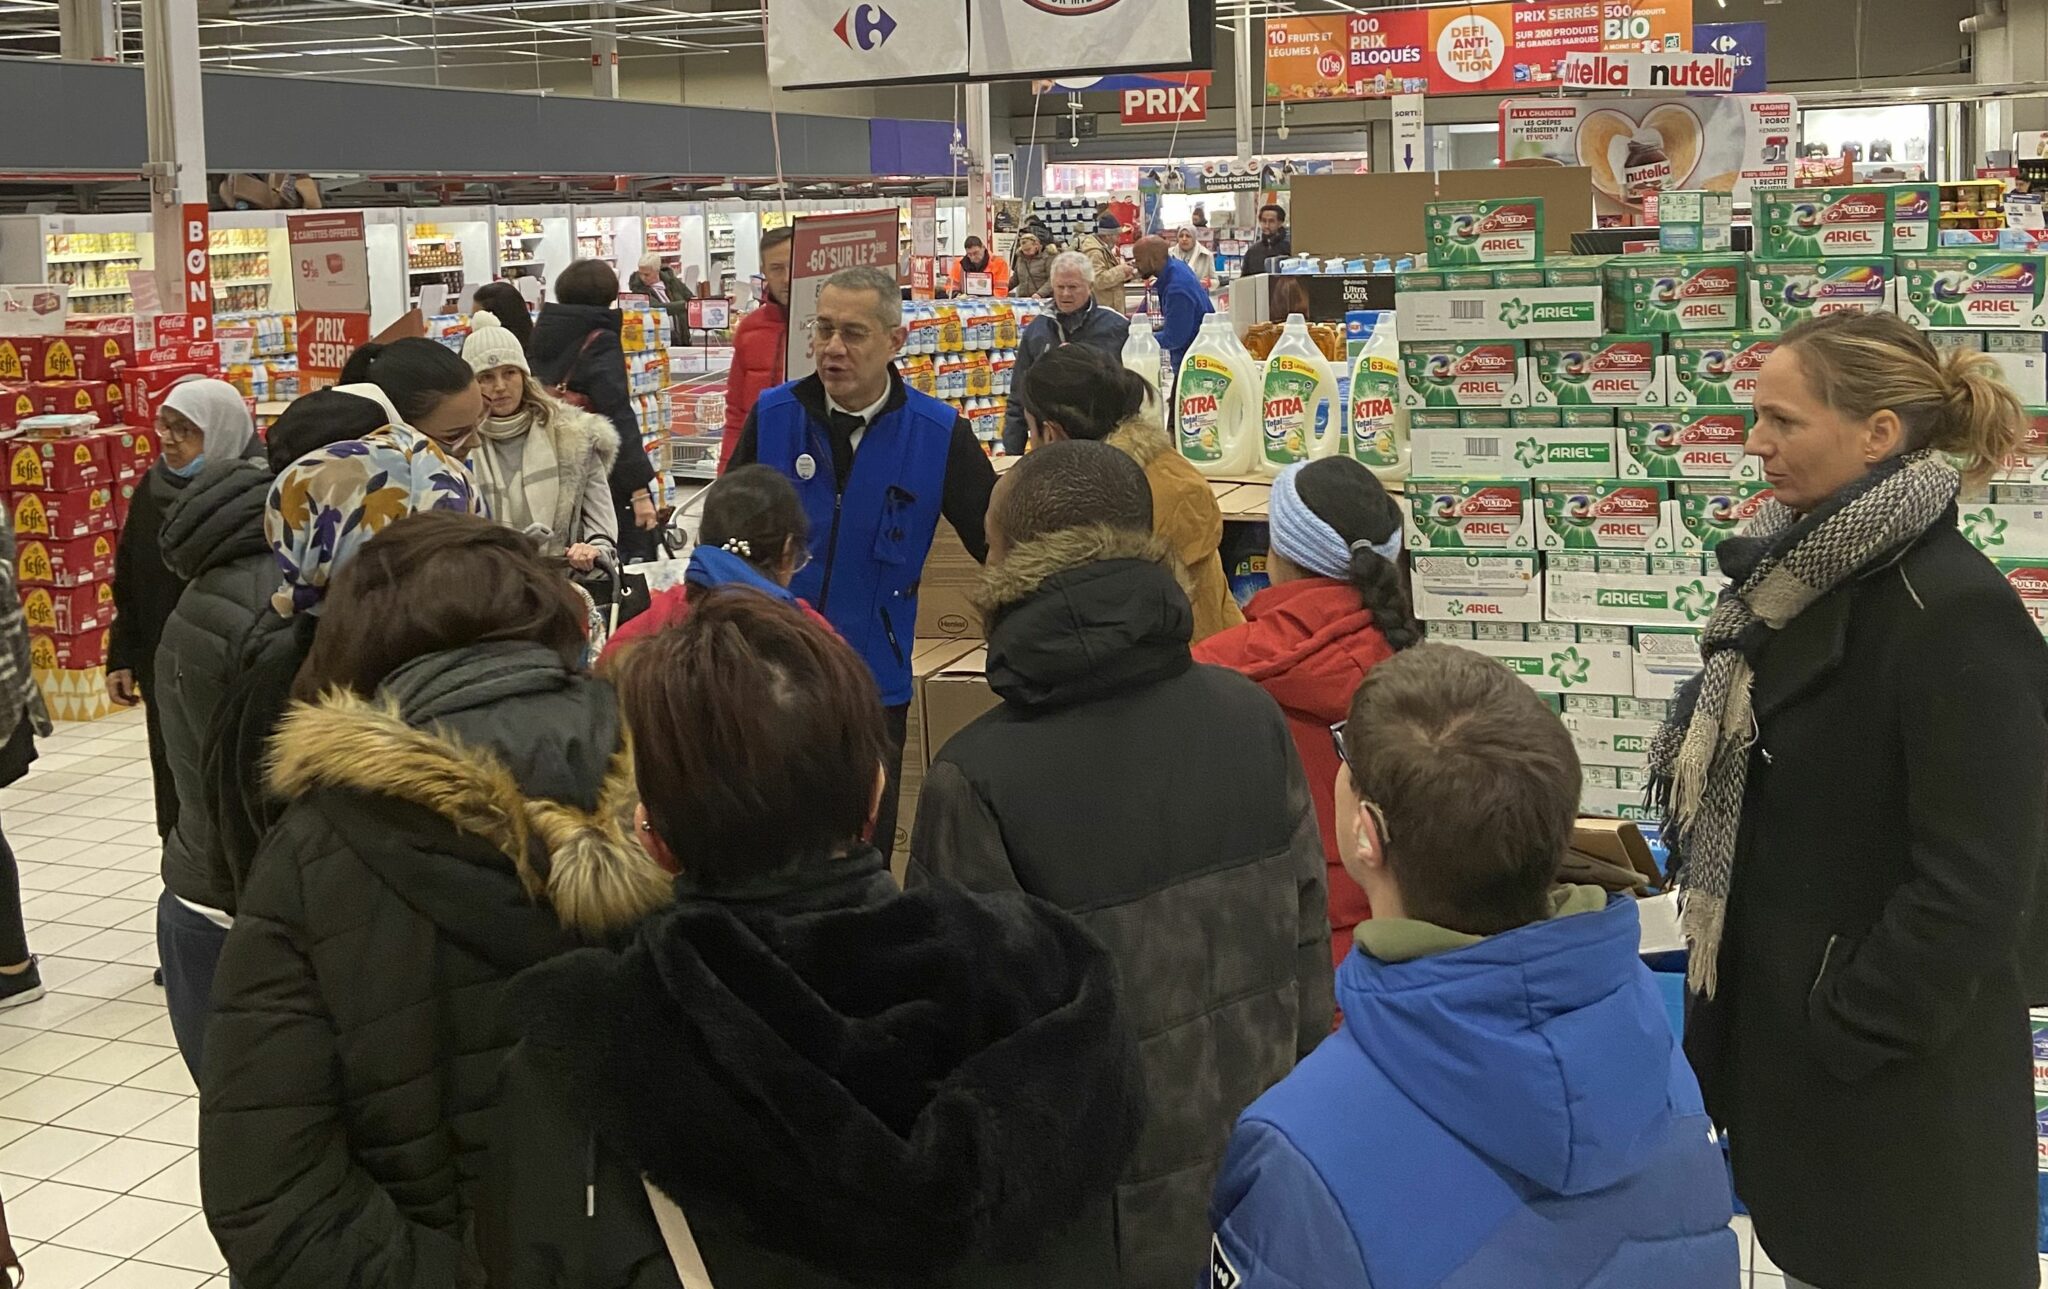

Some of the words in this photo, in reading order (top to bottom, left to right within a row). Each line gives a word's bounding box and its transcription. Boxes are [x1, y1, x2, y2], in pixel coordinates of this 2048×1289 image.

[1515, 10, 1546, 23] PRIX
[1548, 3, 1599, 20] SERRÉS
[1604, 5, 1631, 17] 500
[1632, 7, 1666, 16] PRODUITS
[1350, 18, 1379, 33] 100
[1604, 17, 1650, 40] BIO
[1269, 30, 1286, 44] 10
[1287, 33, 1320, 43] FRUITS
[1321, 32, 1333, 41] ET
[1451, 26, 1484, 38] DEFI
[1515, 31, 1533, 40] SUR
[1535, 29, 1553, 38] 200
[1554, 26, 1599, 37] PRODUITS
[1350, 35, 1386, 49] PRIX
[1453, 37, 1494, 49] ANTI-
[1526, 38, 1561, 48] GRANDES
[1562, 36, 1599, 45] MARQUES
[1268, 46, 1311, 58] LÉGUMES
[1312, 44, 1320, 55] À
[1351, 45, 1421, 65] BLOQUÉS
[1448, 49, 1492, 61] INFLA
[1456, 61, 1492, 72] TION
[1650, 57, 1733, 87] nutella
[1124, 87, 1200, 116] PRIX
[1759, 103, 1789, 111] GAGNER
[1626, 164, 1671, 182] nutella
[1848, 205, 1876, 214] ULTRA
[1500, 215, 1527, 224] ULTRA
[1824, 230, 1872, 243] ARIEL
[1481, 239, 1525, 251] ARIEL
[830, 245, 854, 269] SUR
[855, 244, 867, 265] LE
[1703, 279, 1730, 288] ULTRA
[1344, 286, 1366, 294] Ultra
[1343, 292, 1369, 301] DOUX
[1682, 304, 1726, 317] ARIEL
[1967, 300, 2020, 312] ARIEL
[1533, 307, 1577, 319] ARIEL
[159, 316, 187, 329] Coca-Cola
[316, 317, 346, 342] PRIX
[150, 348, 177, 362] Coca-Cola
[188, 344, 214, 358] Coca-Cola
[50, 351, 71, 371] Leffe
[1196, 359, 1208, 368] 63
[1281, 360, 1293, 370] 63
[1477, 358, 1505, 366] ULTRA
[1613, 355, 1642, 363] ULTRA
[1371, 361, 1383, 370] 63
[1458, 381, 1503, 393] ARIEL
[1592, 378, 1640, 391] ARIEL
[1183, 416, 1198, 425] Total
[1267, 418, 1283, 427] Total
[1357, 418, 1373, 427] Total
[1704, 428, 1734, 436] ULTRA
[1549, 446, 1594, 459] ARIEL
[1683, 452, 1732, 464] ARIEL
[15, 460, 38, 480] Leffe
[1483, 500, 1512, 508] ULTRA
[1618, 500, 1648, 508] ULTRA
[20, 507, 42, 529] Leffe
[1464, 522, 1510, 534] ARIEL
[1599, 523, 1647, 536] ARIEL
[26, 555, 48, 576] Leffe
[1251, 561, 1266, 571] 63
[2016, 580, 2048, 589] ULTRA
[1600, 592, 1648, 606] ARIEL
[28, 603, 51, 624] Leffe
[1465, 603, 1503, 615] ARIEL
